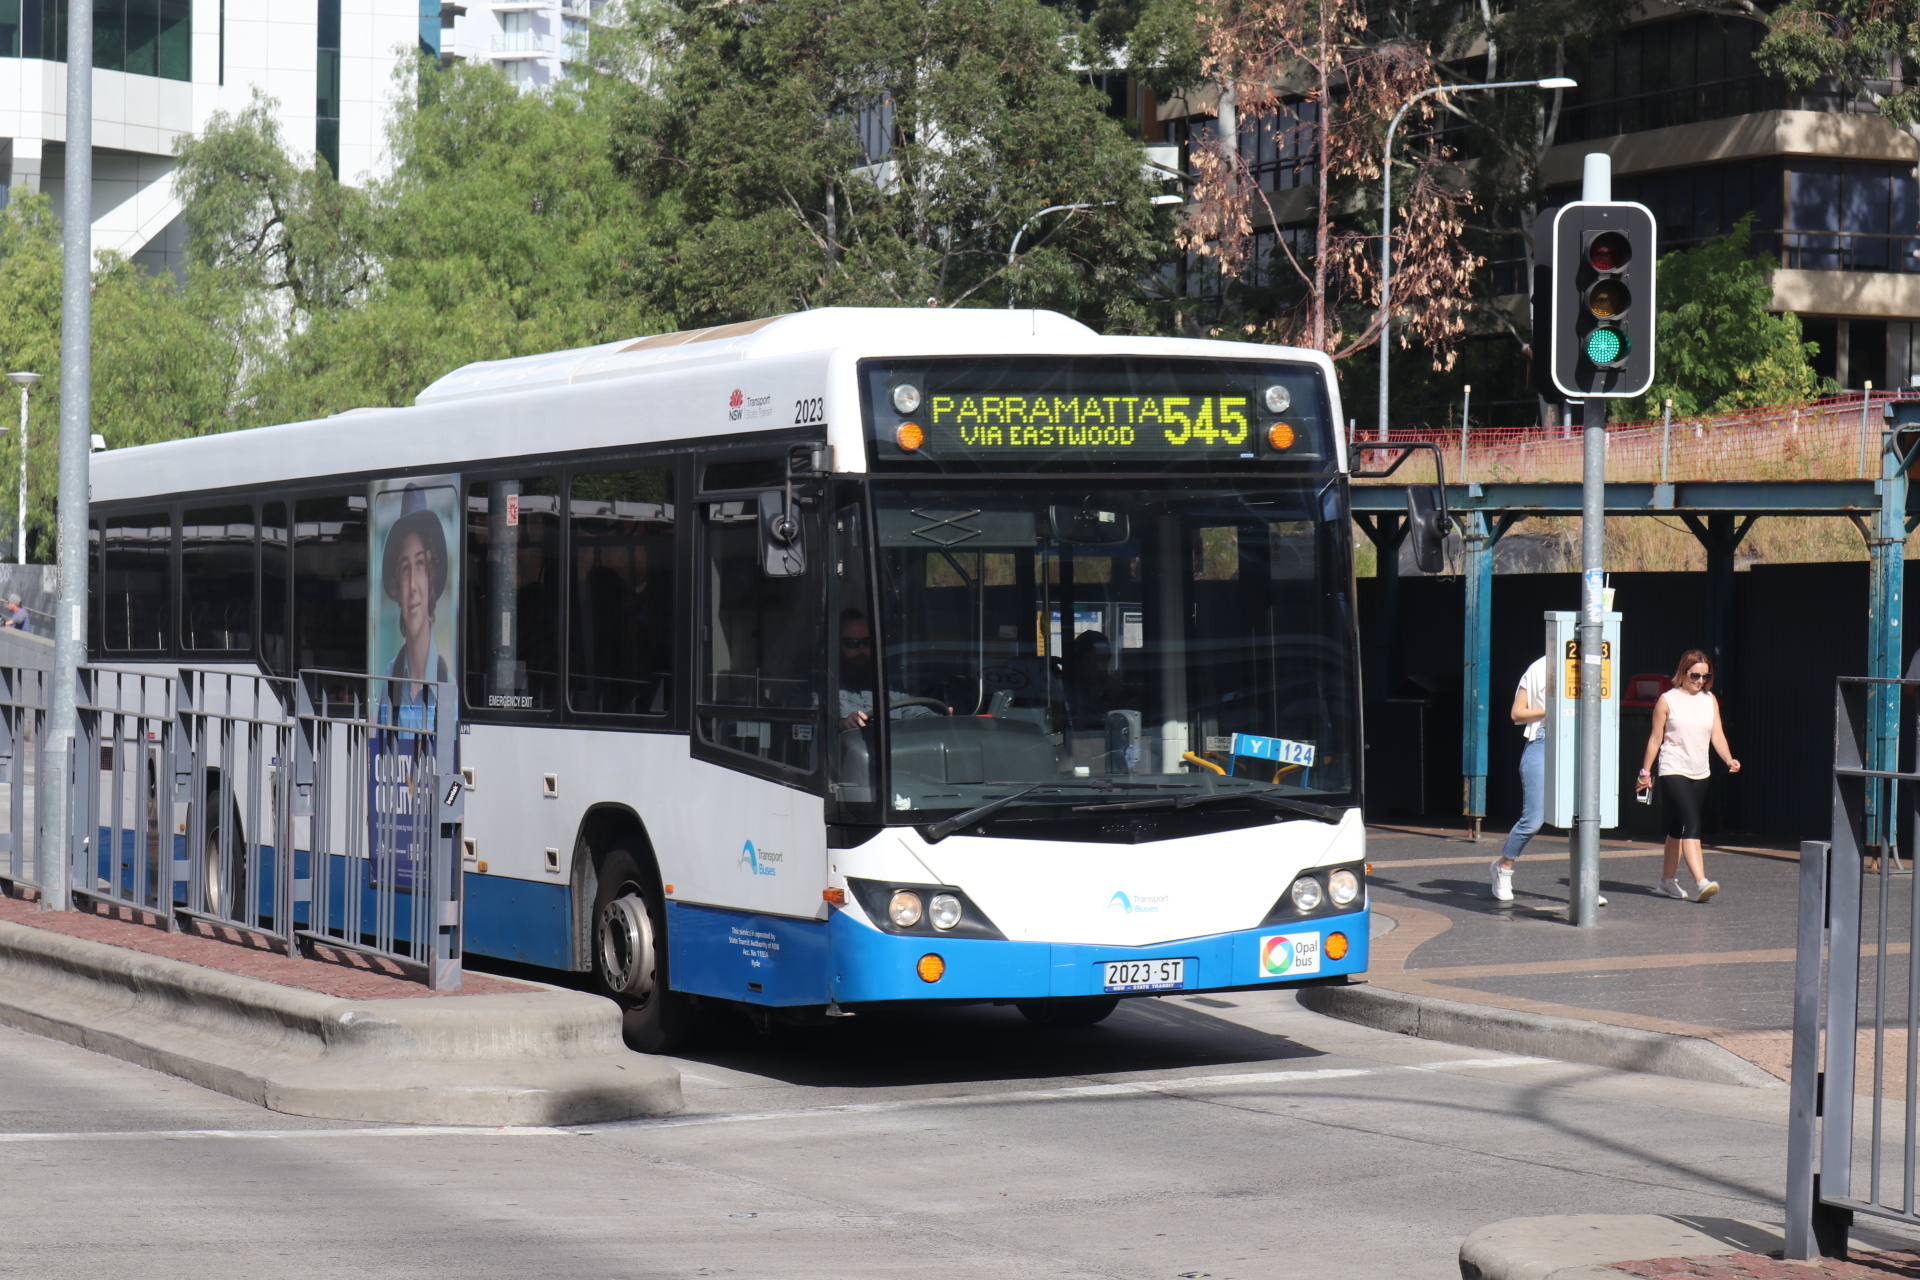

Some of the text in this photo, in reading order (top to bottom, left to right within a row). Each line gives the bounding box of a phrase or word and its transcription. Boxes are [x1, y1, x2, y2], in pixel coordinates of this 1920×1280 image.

[747, 395, 771, 407] Transport
[729, 409, 743, 421] NSW
[795, 397, 824, 424] 2023
[933, 396, 1162, 424] PARRAMATTA
[1162, 397, 1248, 445] 545
[960, 426, 1135, 445] VIA EASTWOOD
[488, 695, 533, 708] EMERGENCY EXIT
[460, 725, 470, 734] APN
[1250, 739, 1263, 753] Y
[1284, 743, 1313, 765] 124
[758, 849, 782, 863] Transport
[759, 864, 776, 876] Buses
[1133, 895, 1169, 904] Transport
[1135, 905, 1158, 913] Buses
[1295, 940, 1318, 956] Opal
[1295, 955, 1312, 967] bus
